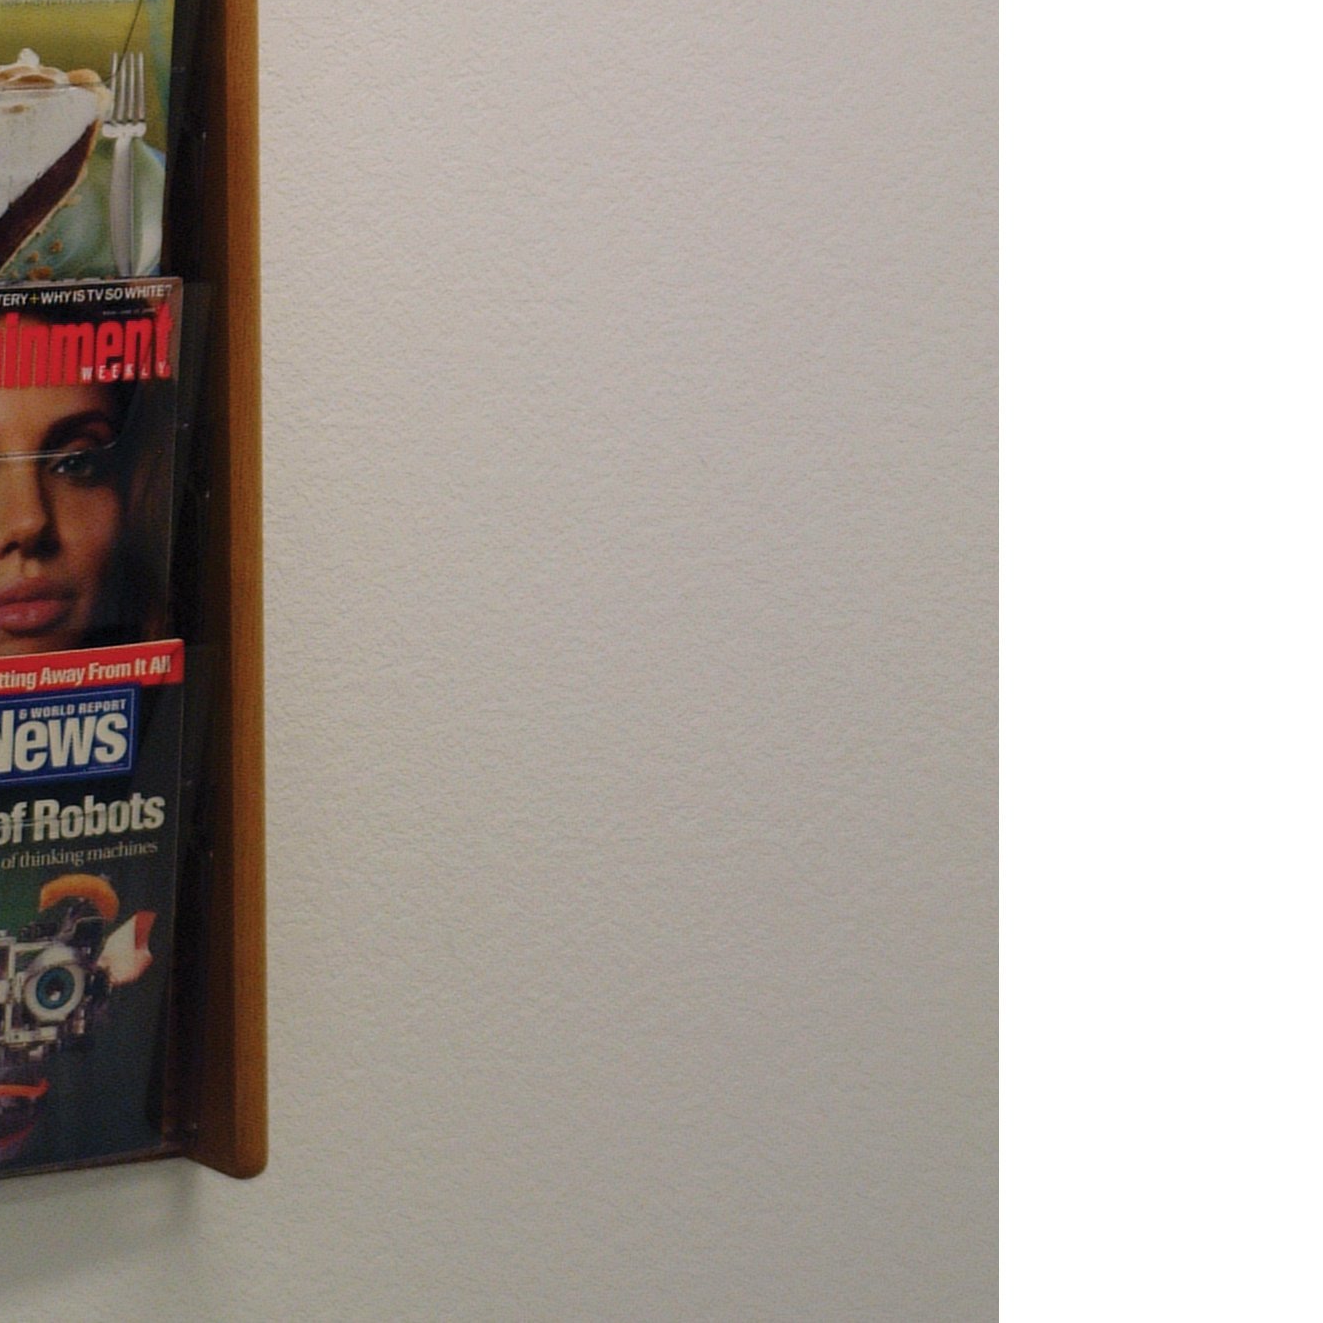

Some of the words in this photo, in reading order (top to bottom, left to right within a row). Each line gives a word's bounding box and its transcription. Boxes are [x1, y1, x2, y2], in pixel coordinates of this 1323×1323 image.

[40, 290, 72, 305] WHY
[73, 289, 86, 303] IS
[87, 288, 104, 301] TV
[105, 287, 124, 300] SO
[124, 283, 173, 299] WHITE?
[39, 667, 86, 687] Away
[88, 662, 132, 680] From
[134, 657, 147, 676] It
[31, 703, 75, 719] WORLD
[78, 698, 127, 714] REPORT
[33, 792, 166, 842] Robots
[0, 851, 20, 870] of
[19, 847, 84, 869] thinking
[87, 840, 159, 861] machines
